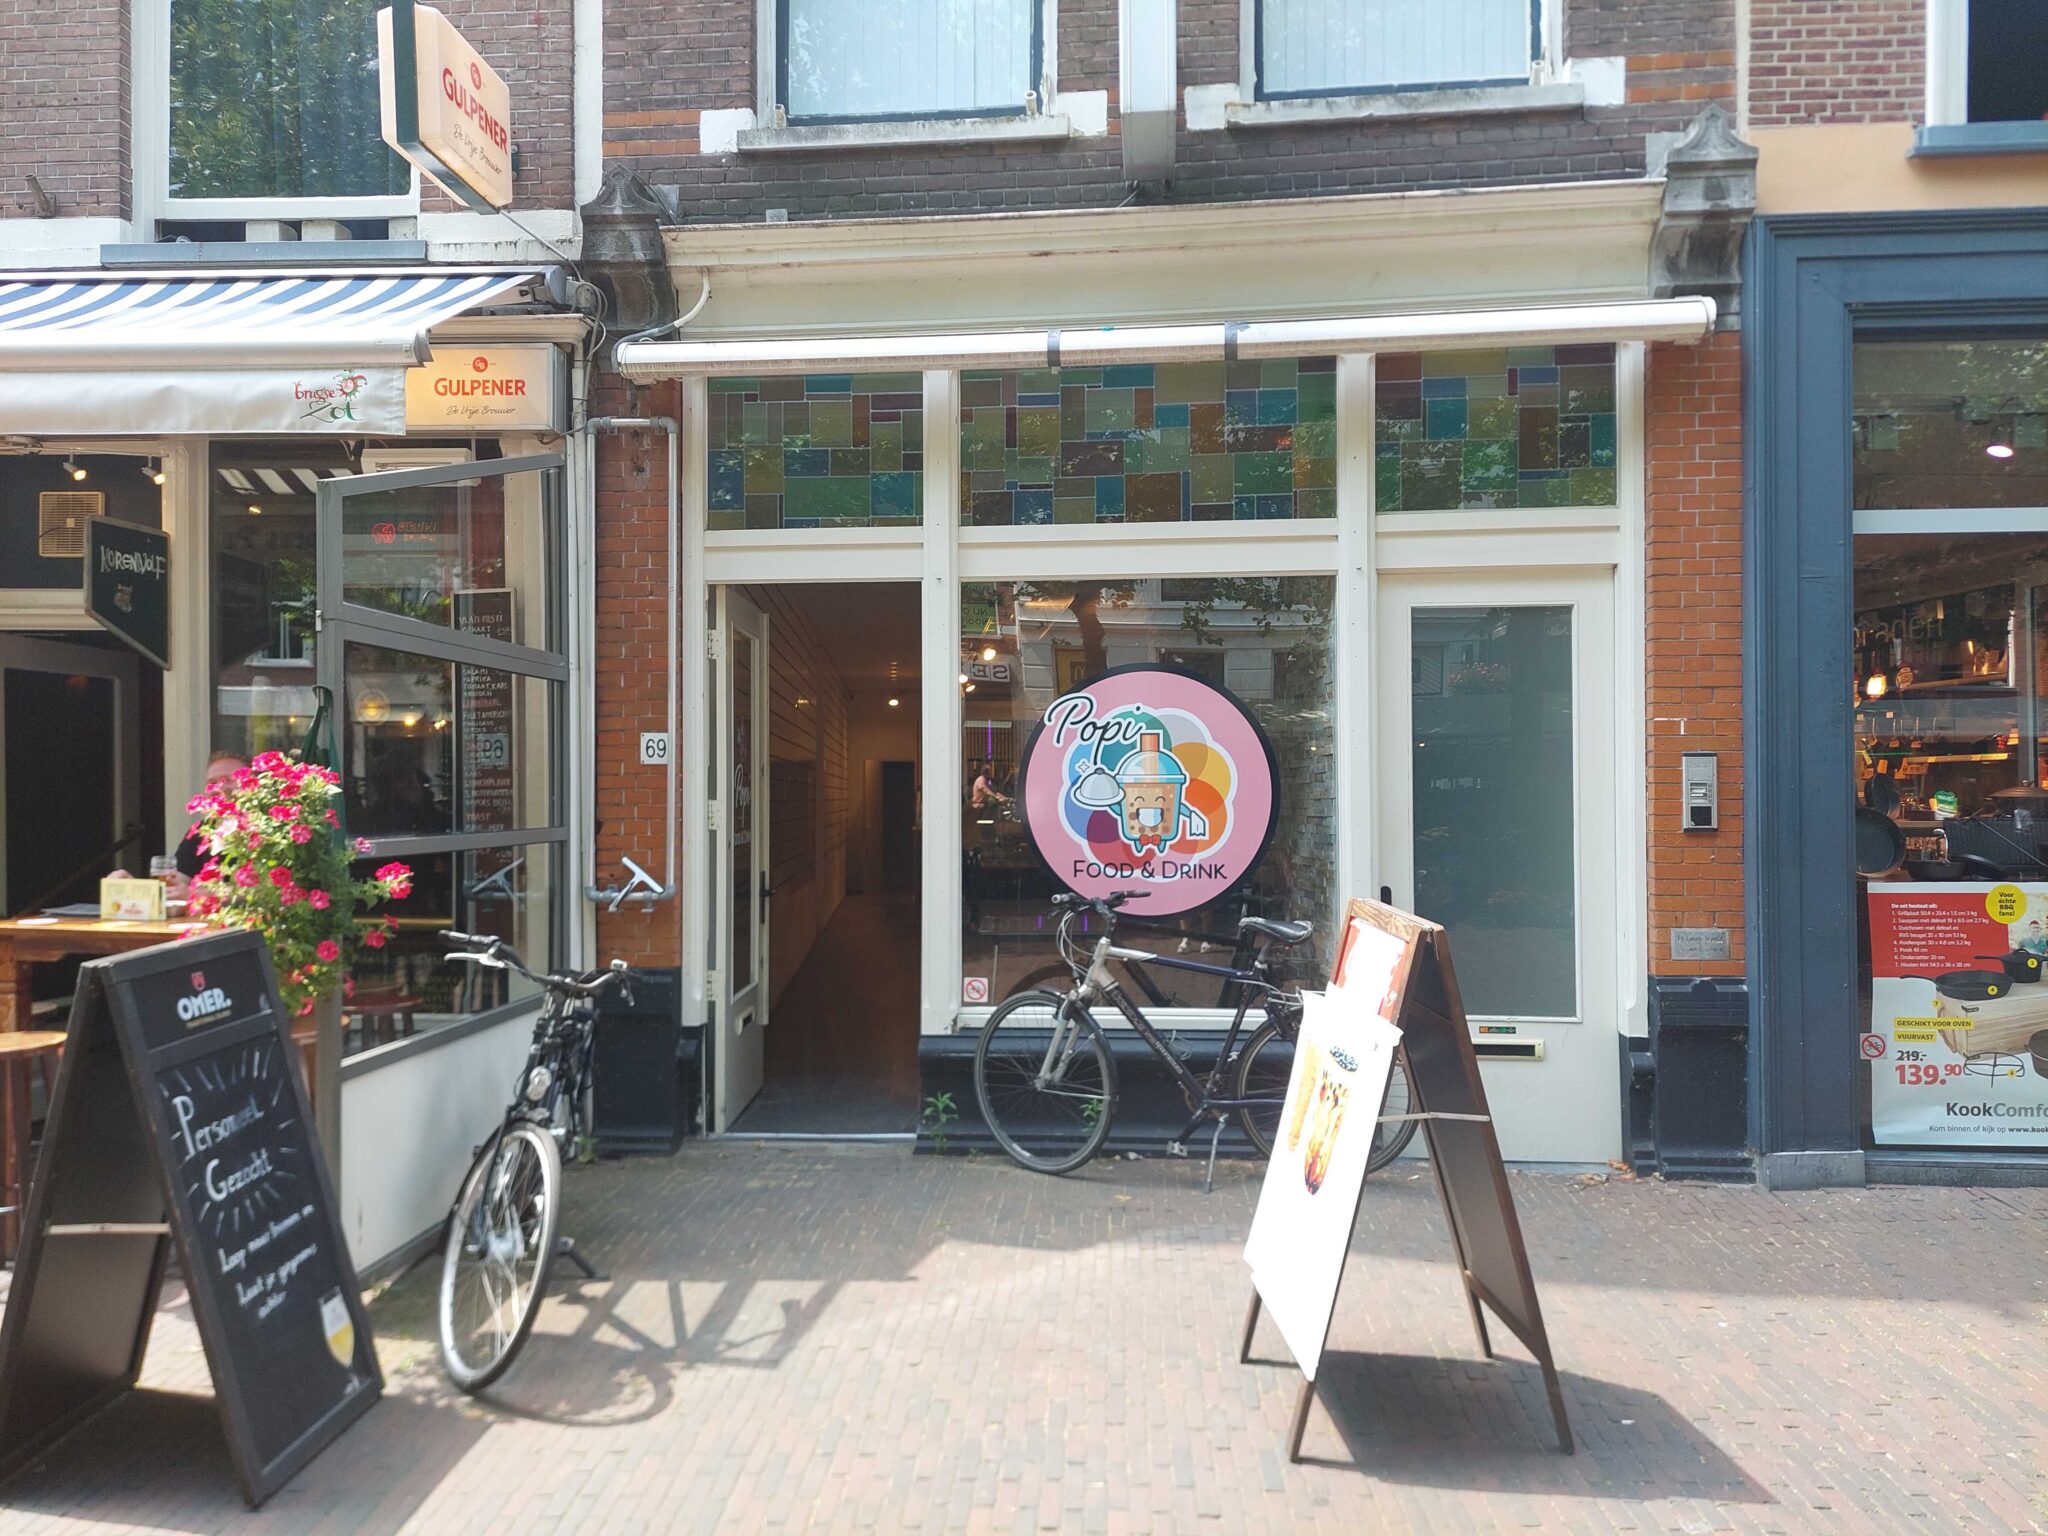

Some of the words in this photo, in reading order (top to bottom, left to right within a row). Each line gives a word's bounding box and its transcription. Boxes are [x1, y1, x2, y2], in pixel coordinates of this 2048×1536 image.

[442, 67, 508, 155] GULPENER
[453, 123, 464, 141] De
[479, 146, 502, 175] Brouwer
[434, 377, 526, 397] GULPENER
[299, 400, 364, 424] Zot
[446, 405, 460, 416] De
[481, 405, 517, 416] Brouwer
[1047, 696, 1143, 766] Popi
[645, 738, 667, 759] 69
[1073, 860, 1134, 880] FOOD
[1141, 860, 1155, 879] &
[1162, 861, 1228, 880] DRINK
[1897, 1033, 1934, 1041] VUURVAST
[171, 1095, 264, 1160] Personeel
[1947, 1125, 1971, 1133] binnen
[1973, 1125, 1981, 1133] of
[1982, 1125, 1995, 1134] kijk
[1996, 1126, 2006, 1134] op
